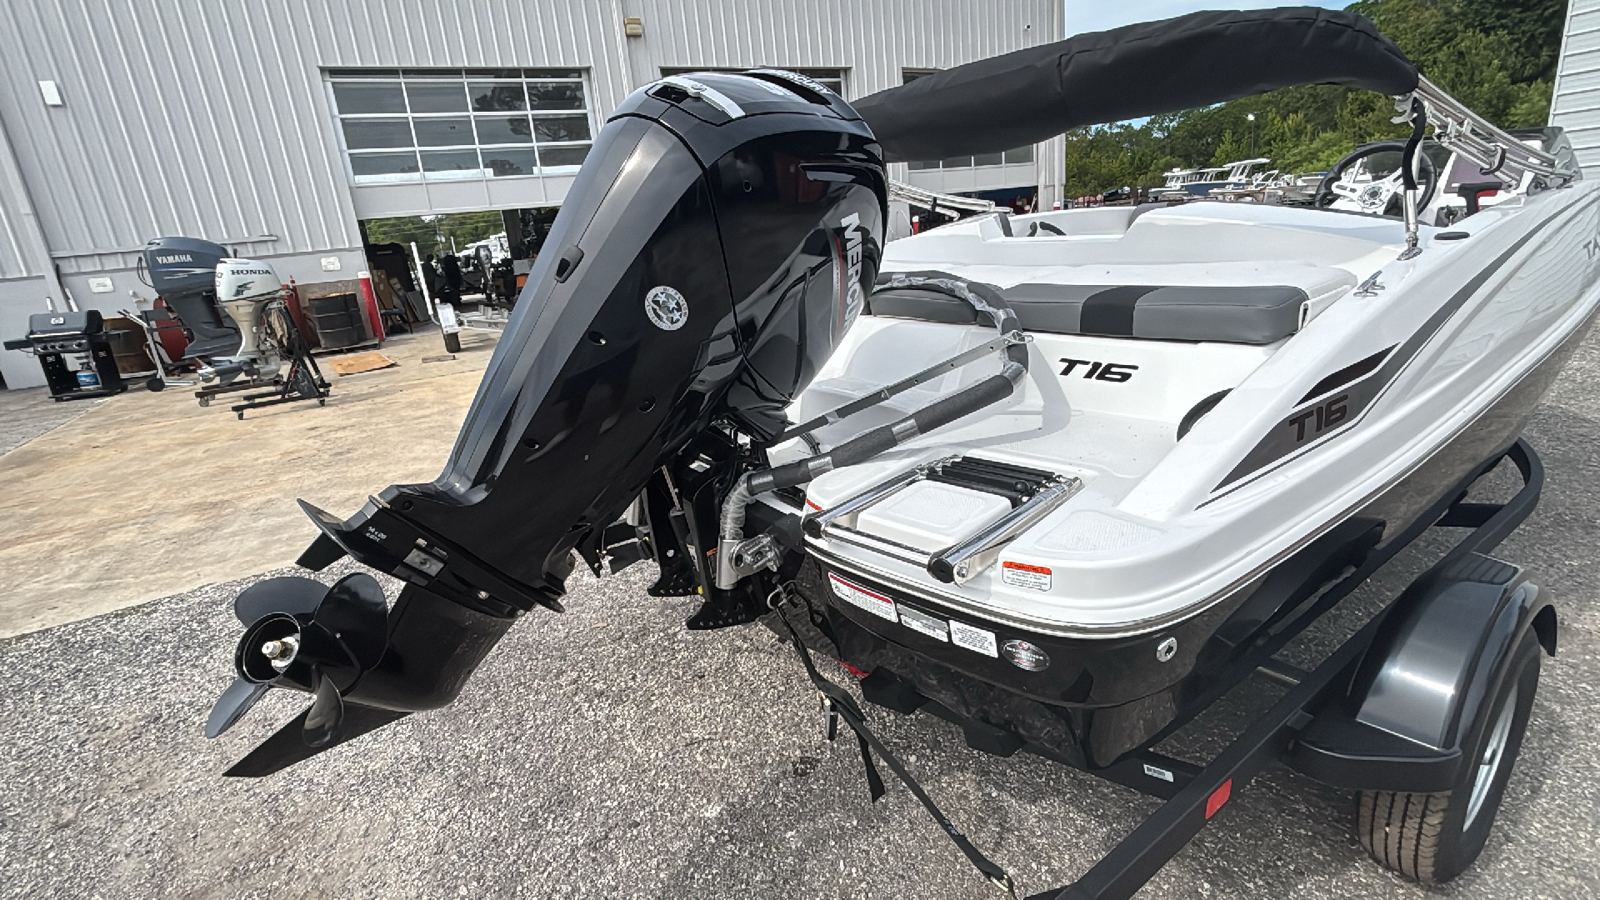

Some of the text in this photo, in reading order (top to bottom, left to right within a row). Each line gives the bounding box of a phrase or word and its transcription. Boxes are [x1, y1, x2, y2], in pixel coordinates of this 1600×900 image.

[156, 254, 193, 265] YAMAHA
[840, 211, 863, 337] MERCUR
[1058, 357, 1139, 383] T16
[1288, 394, 1349, 442] T16
